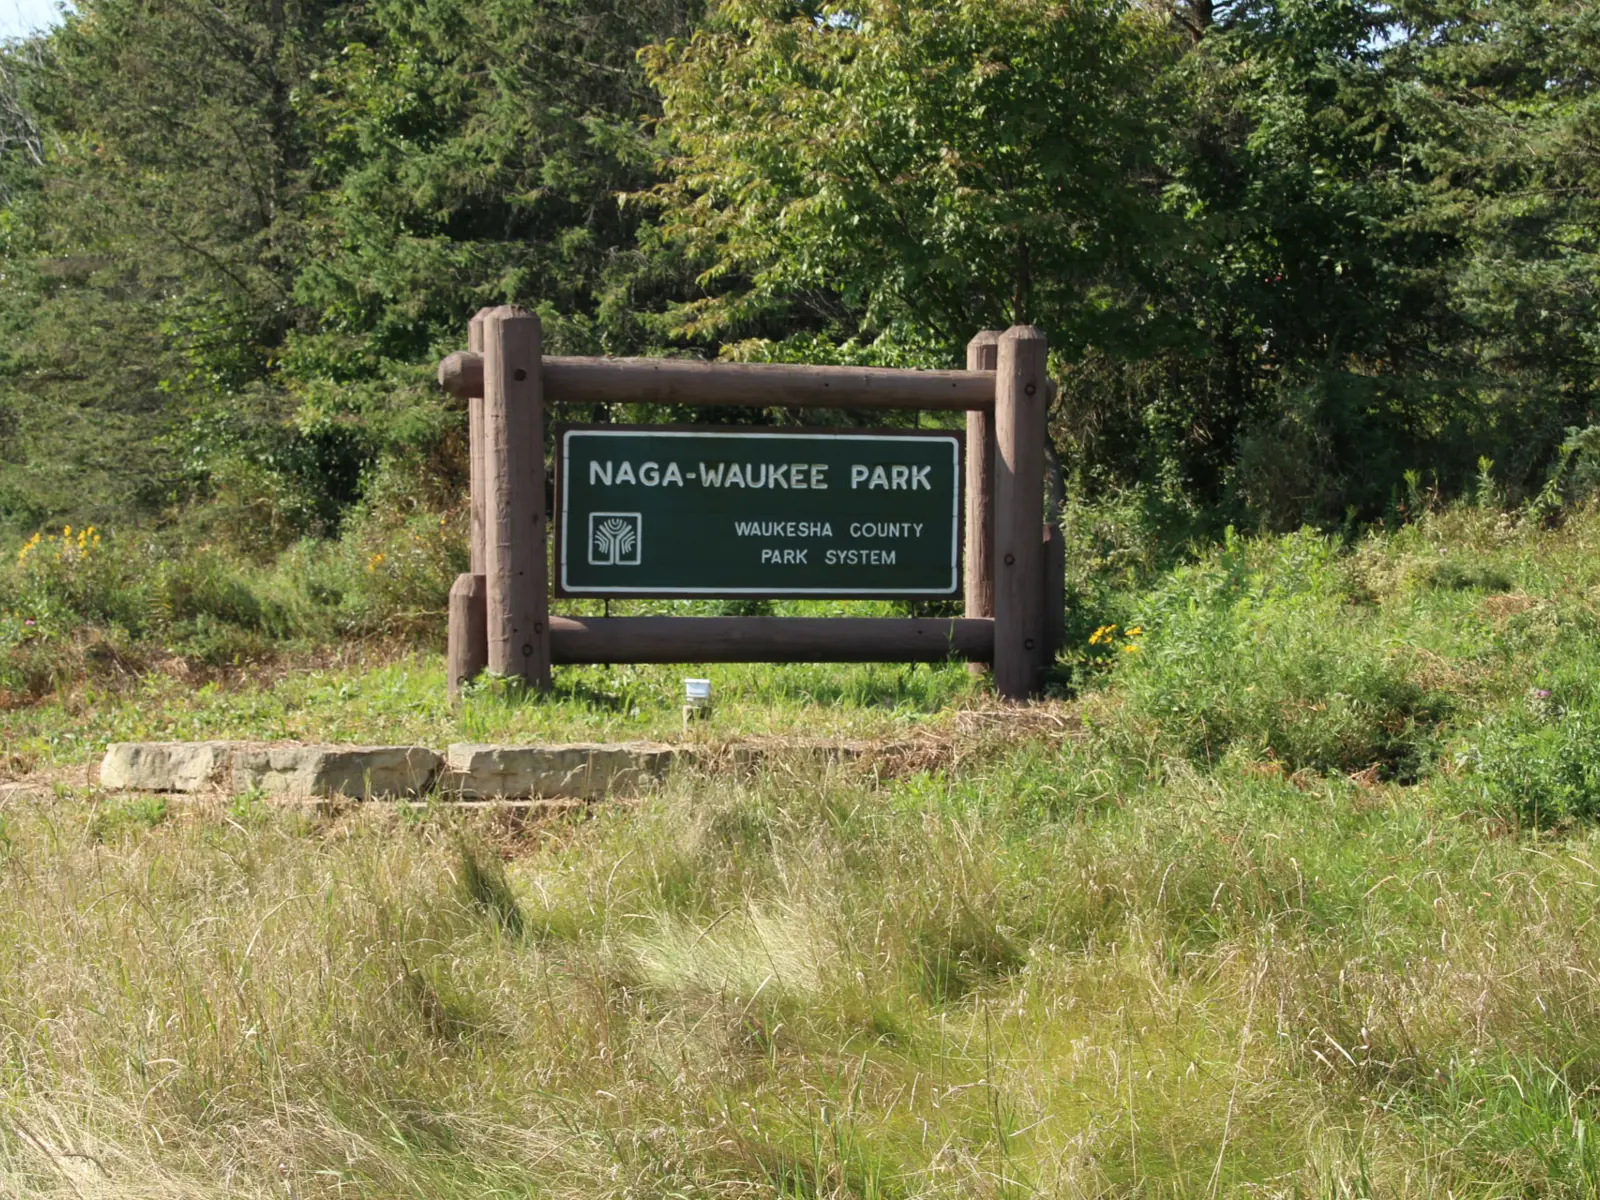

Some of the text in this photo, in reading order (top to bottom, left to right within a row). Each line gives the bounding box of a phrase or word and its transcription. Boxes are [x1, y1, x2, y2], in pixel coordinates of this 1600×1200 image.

[589, 460, 932, 491] NAGA-WAUKEE PARK
[735, 521, 923, 539] WAUKESHA COUNTY
[760, 548, 897, 565] PARK SYSTEM
